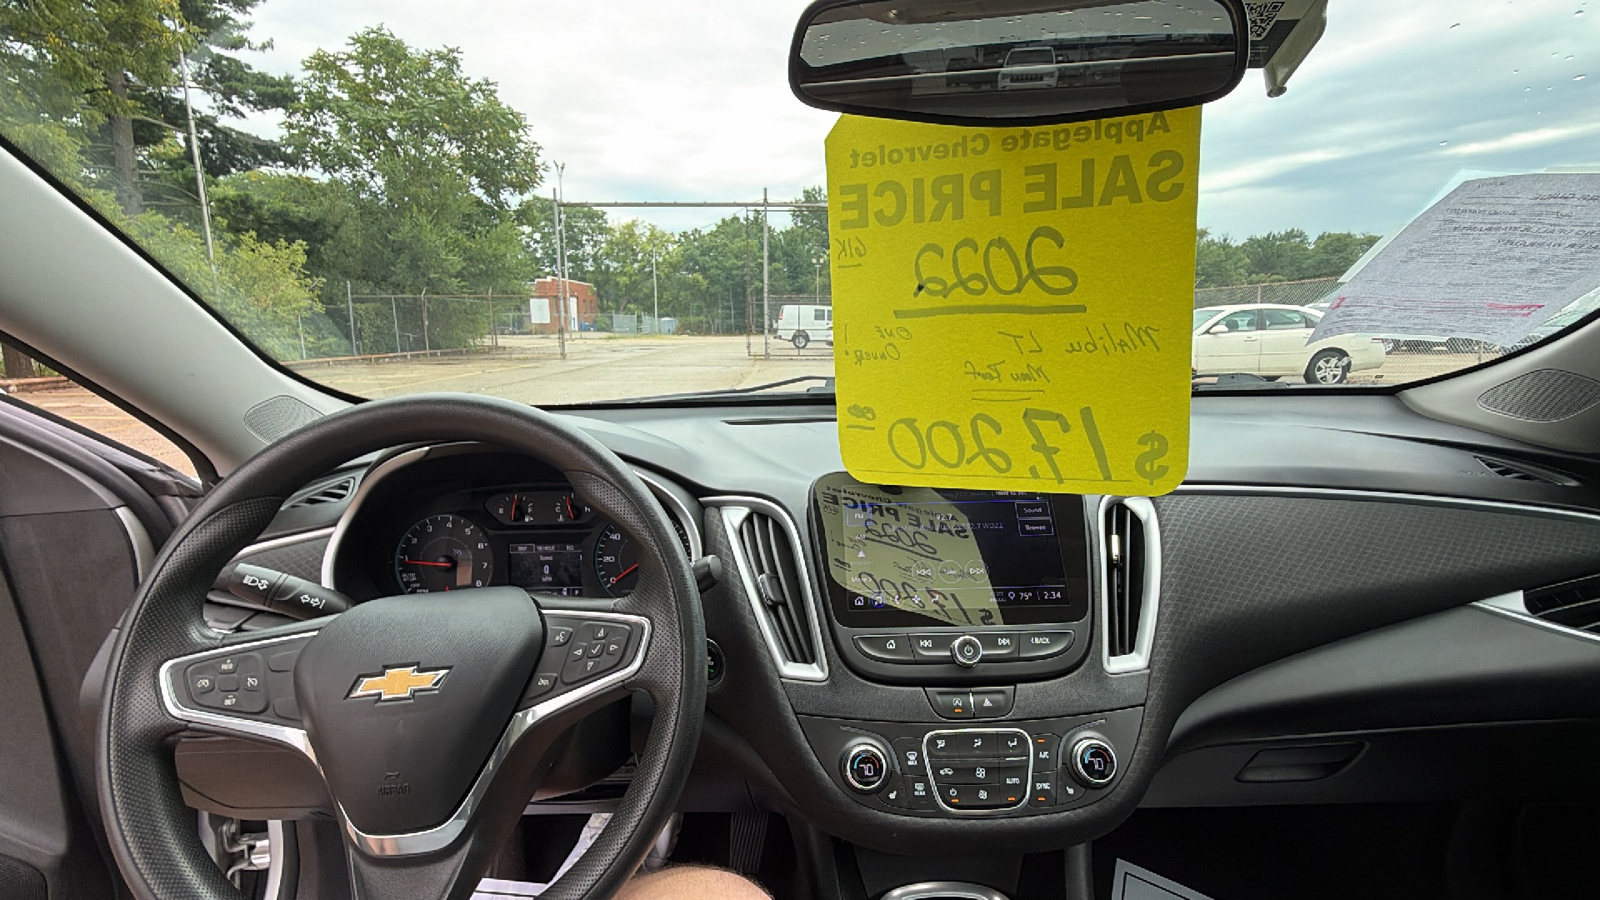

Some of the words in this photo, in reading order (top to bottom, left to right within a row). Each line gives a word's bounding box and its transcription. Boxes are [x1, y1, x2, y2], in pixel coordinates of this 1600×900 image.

[446, 521, 453, 529] 4
[609, 533, 621, 541] 40
[543, 564, 550, 574] 0
[475, 579, 483, 588] 8
[1043, 591, 1062, 600] 2:34
[1039, 750, 1050, 759] A/C
[1087, 758, 1104, 770] 70
[859, 763, 874, 776] 70
[1006, 777, 1021, 785] AUTO
[1035, 782, 1051, 791] SYNC
